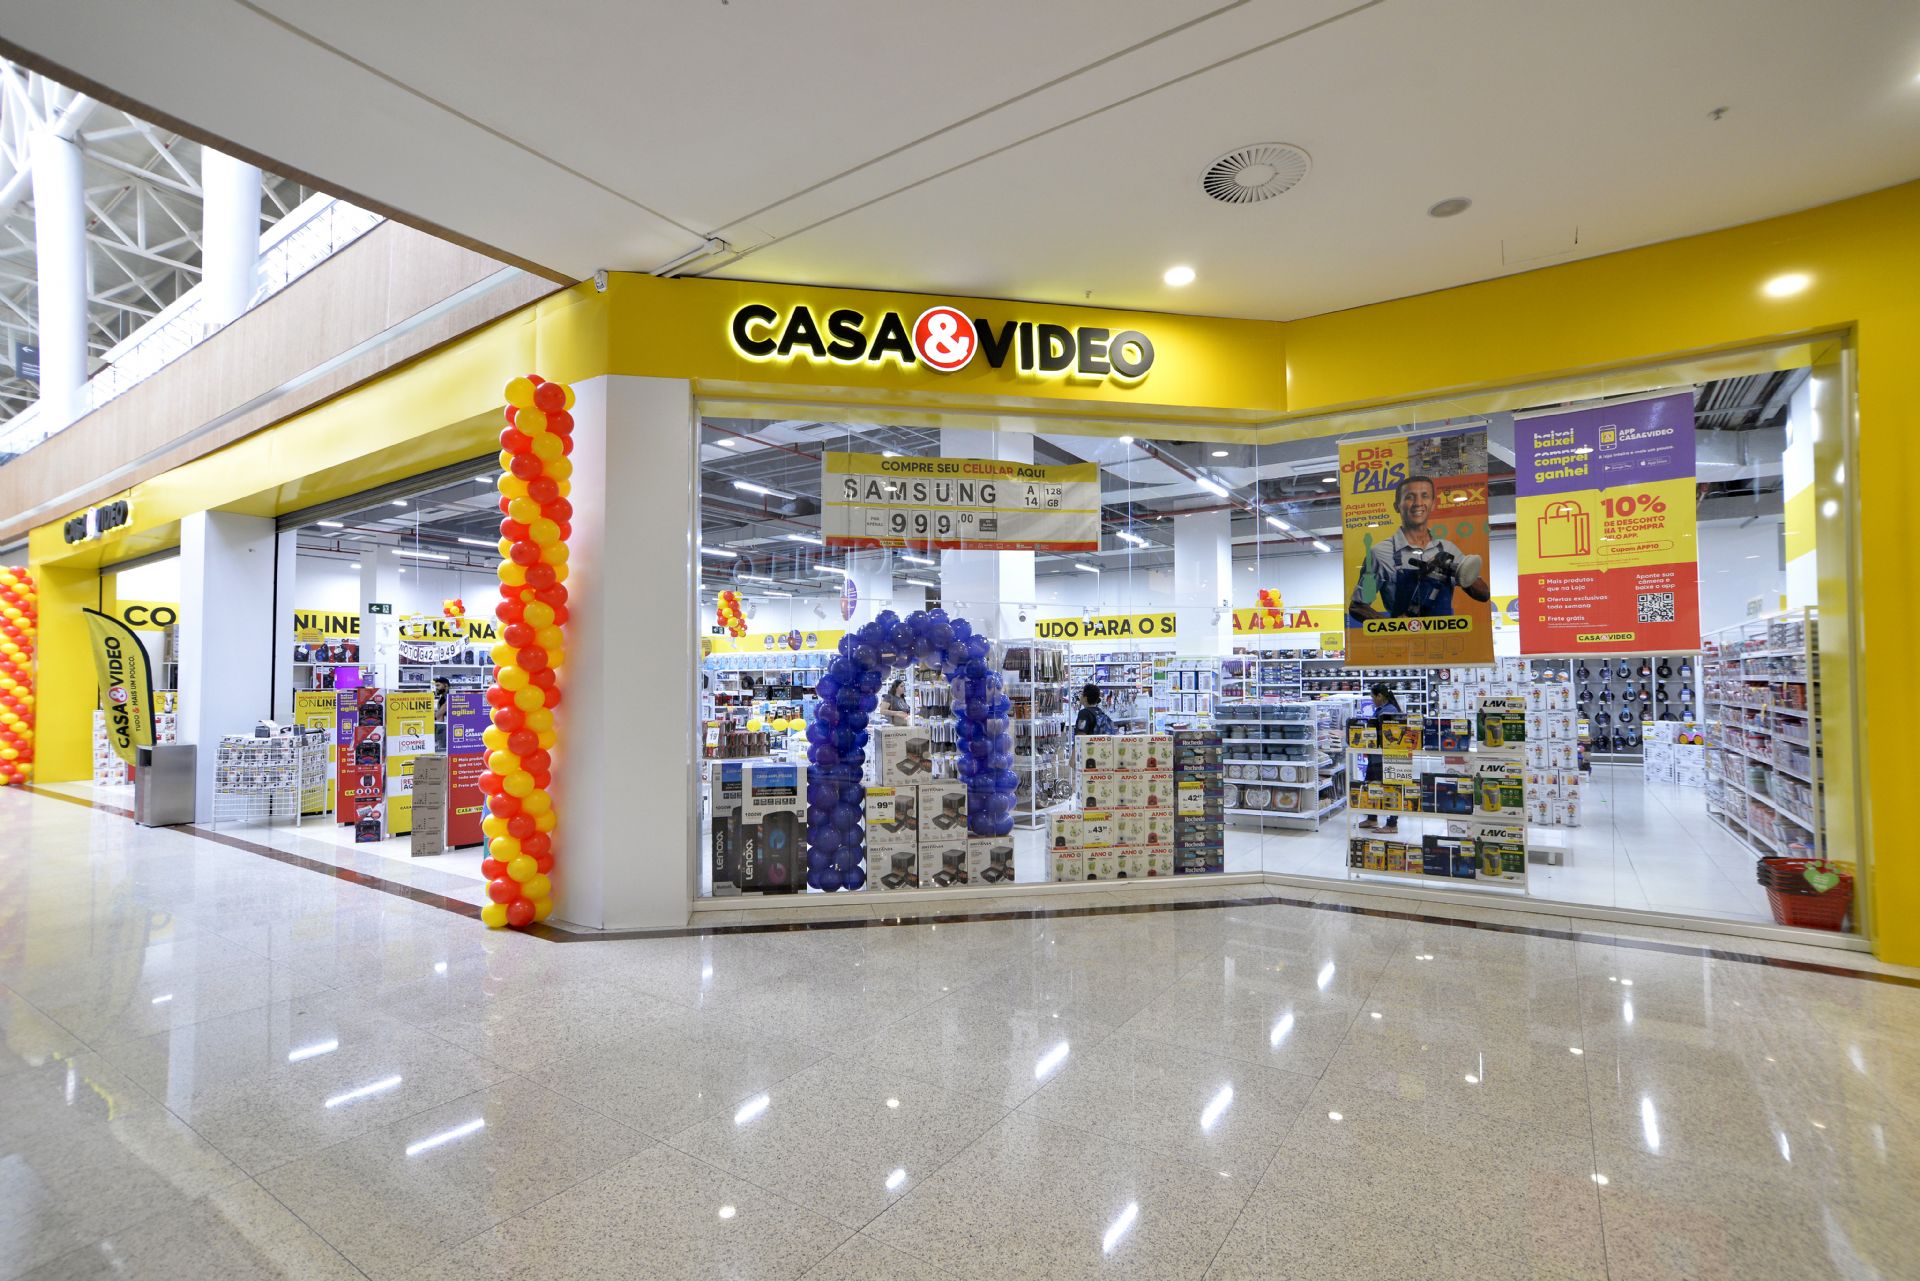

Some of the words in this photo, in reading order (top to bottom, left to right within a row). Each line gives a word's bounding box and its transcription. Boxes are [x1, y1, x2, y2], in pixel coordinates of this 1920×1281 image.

[732, 304, 1155, 378] CASA&VIDEO
[1619, 428, 1636, 436] APP
[1534, 435, 1574, 448] baixei
[1358, 447, 1393, 460] Dia
[1342, 460, 1383, 473] dos
[1534, 454, 1588, 467] comprei
[881, 461, 933, 473] COMPRE
[938, 463, 959, 474] SEU
[963, 464, 1013, 476] CELULAR
[1017, 467, 1045, 478] AQUI
[1535, 464, 1588, 484] ganhei
[844, 478, 996, 503] SAMSUNG
[1027, 485, 1035, 495] A
[1046, 486, 1062, 496] 128
[1024, 496, 1038, 506] 14
[1047, 499, 1059, 508] GB
[1601, 494, 1666, 518] 10%
[1346, 508, 1386, 517] presente
[1616, 516, 1666, 526] DESCONTO
[1626, 522, 1664, 532] COMPRA
[1084, 619, 1132, 636] PARA
[1139, 618, 1154, 634] O
[1367, 618, 1468, 632] CASA&VIDEO
[130, 678, 136, 690] UM
[390, 700, 432, 711] ONLINE
